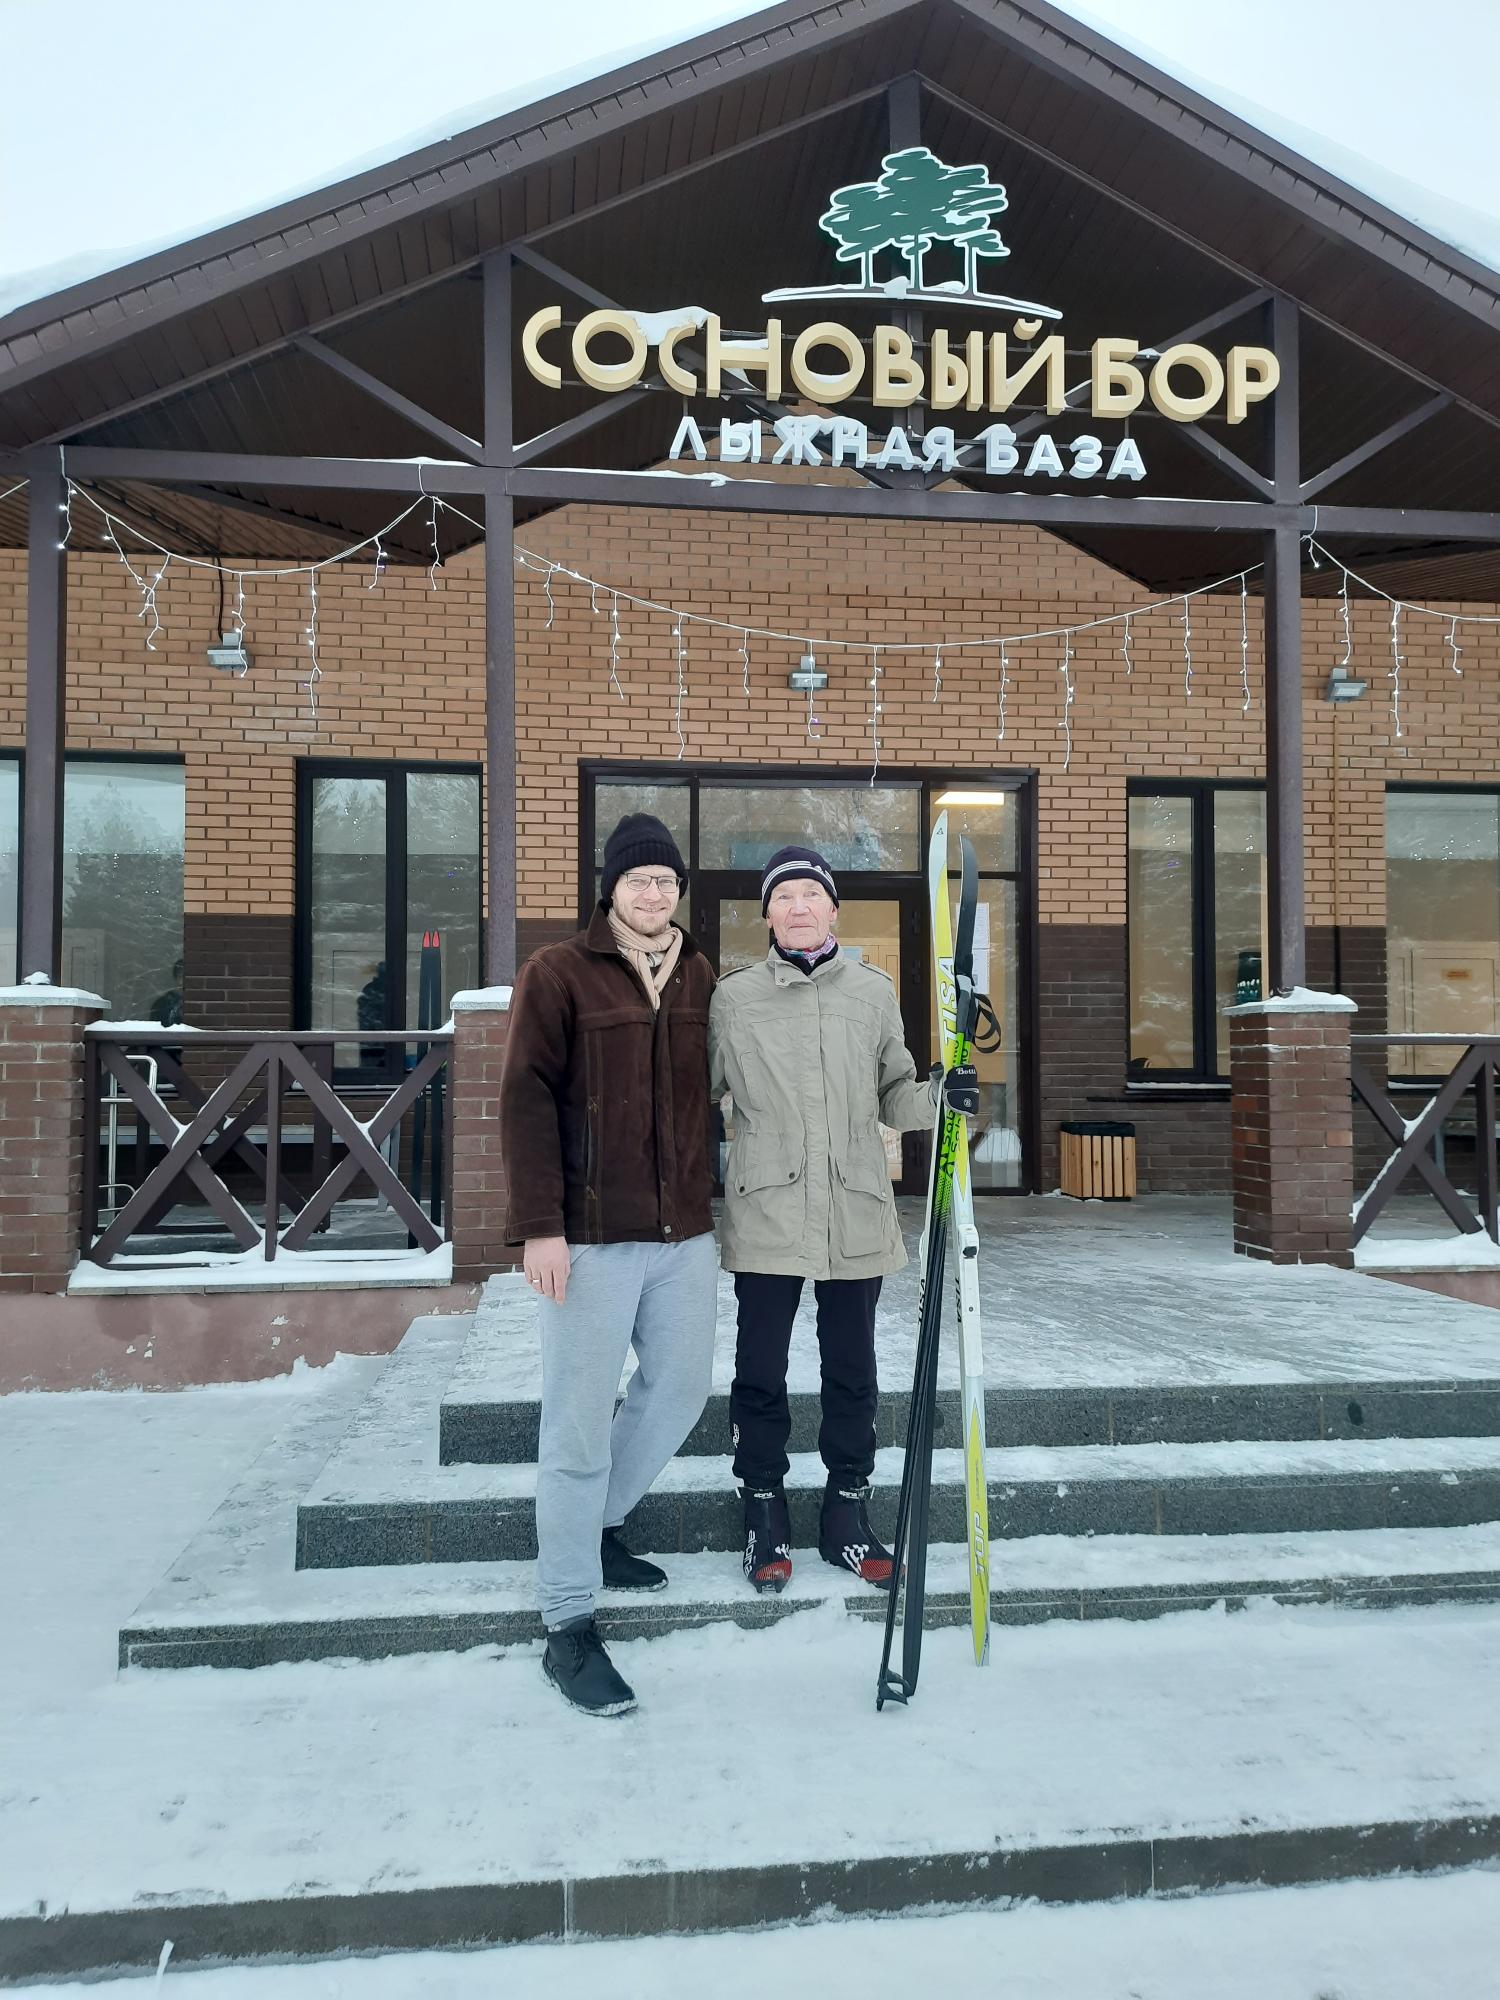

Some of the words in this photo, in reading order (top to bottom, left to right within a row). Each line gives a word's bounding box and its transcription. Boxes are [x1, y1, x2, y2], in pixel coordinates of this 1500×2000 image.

[522, 306, 1065, 416] СОСНОВЫЙ
[1092, 338, 1280, 424] БОР
[669, 415, 956, 472] ЛЫЖНАЯ
[986, 424, 1147, 479] БАЗА
[940, 957, 957, 1047] TISA
[743, 1529, 755, 1577] alpina
[973, 1511, 986, 1577] TOP
